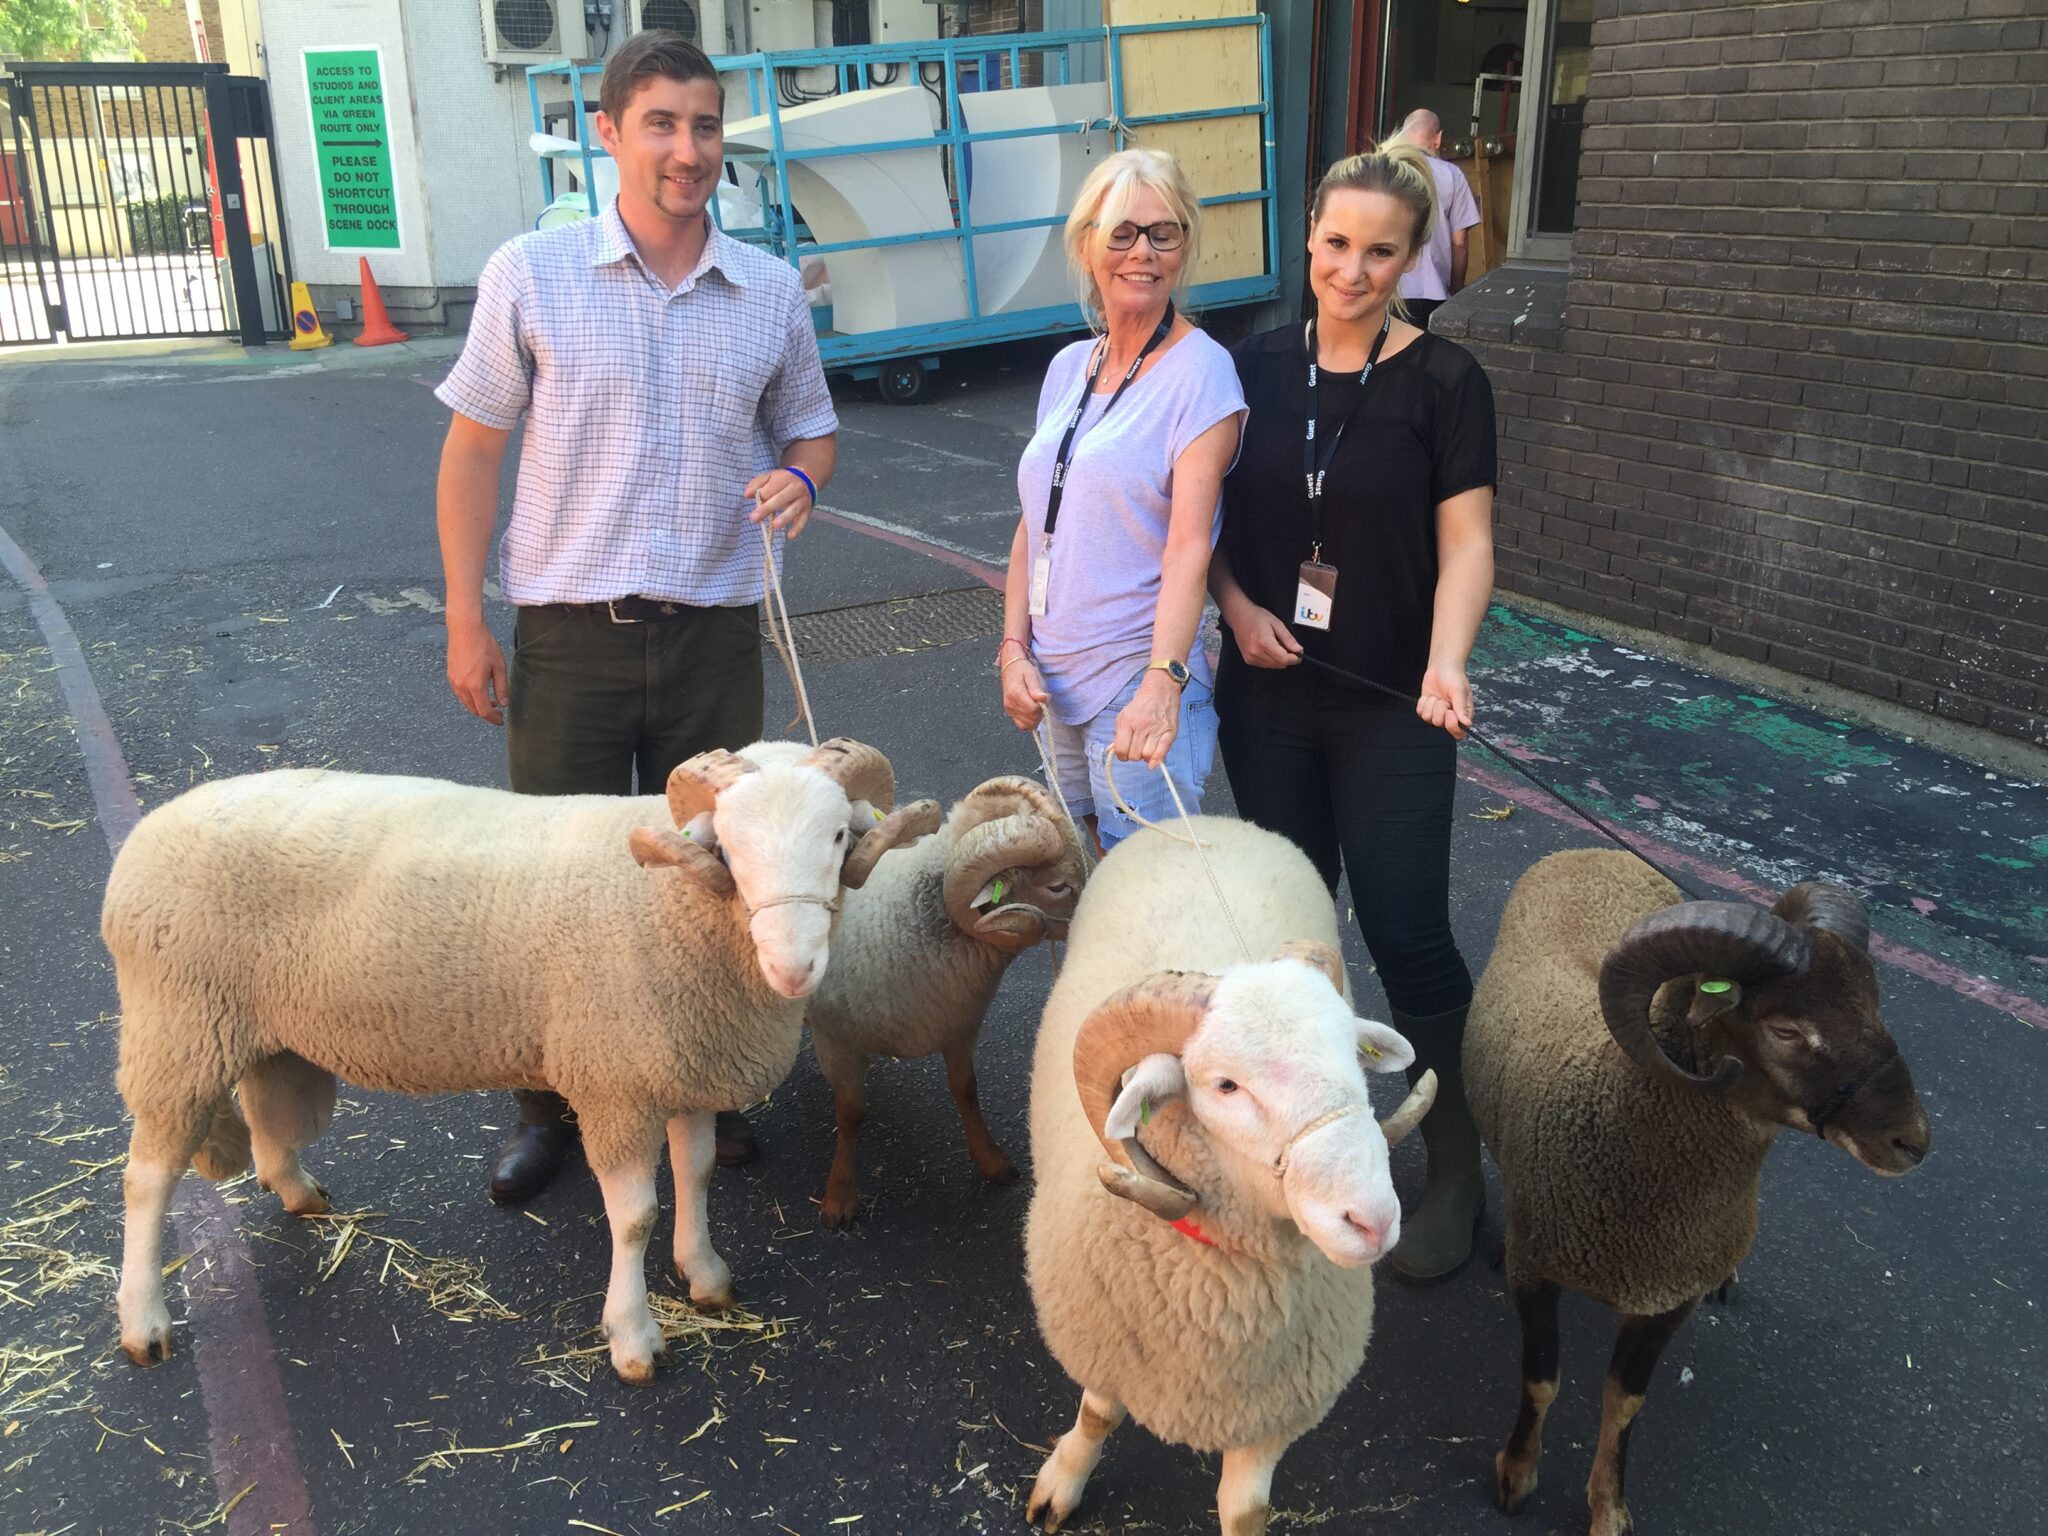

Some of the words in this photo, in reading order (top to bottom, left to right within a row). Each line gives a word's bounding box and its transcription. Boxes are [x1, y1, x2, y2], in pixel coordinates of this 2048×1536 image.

[316, 66, 355, 76] ACCESS
[358, 66, 372, 76] TO
[312, 81, 354, 91] STUDIOS
[358, 81, 379, 90] AND
[312, 96, 346, 105] CLIENT
[349, 95, 383, 104] AREAS
[322, 110, 338, 119] VIA
[342, 109, 376, 118] GREEN
[320, 123, 352, 133] ROUTE
[356, 123, 381, 132] ONLY
[332, 156, 377, 167] PLEASE
[334, 172, 351, 183] DO
[355, 172, 380, 182] NOT
[327, 188, 391, 199] SHORTCUT
[332, 203, 390, 214] THROUGH
[329, 219, 362, 230] SCENE
[367, 219, 398, 230] DOCK
[1126, 357, 1143, 380] Guest
[1360, 362, 1373, 385] Guest
[1308, 363, 1317, 387] Guest
[1306, 419, 1316, 441] Guest
[1053, 462, 1063, 487] Guest
[1306, 472, 1314, 499] Guest
[1315, 469, 1325, 496] Guest
[1300, 606, 1324, 622] itv
